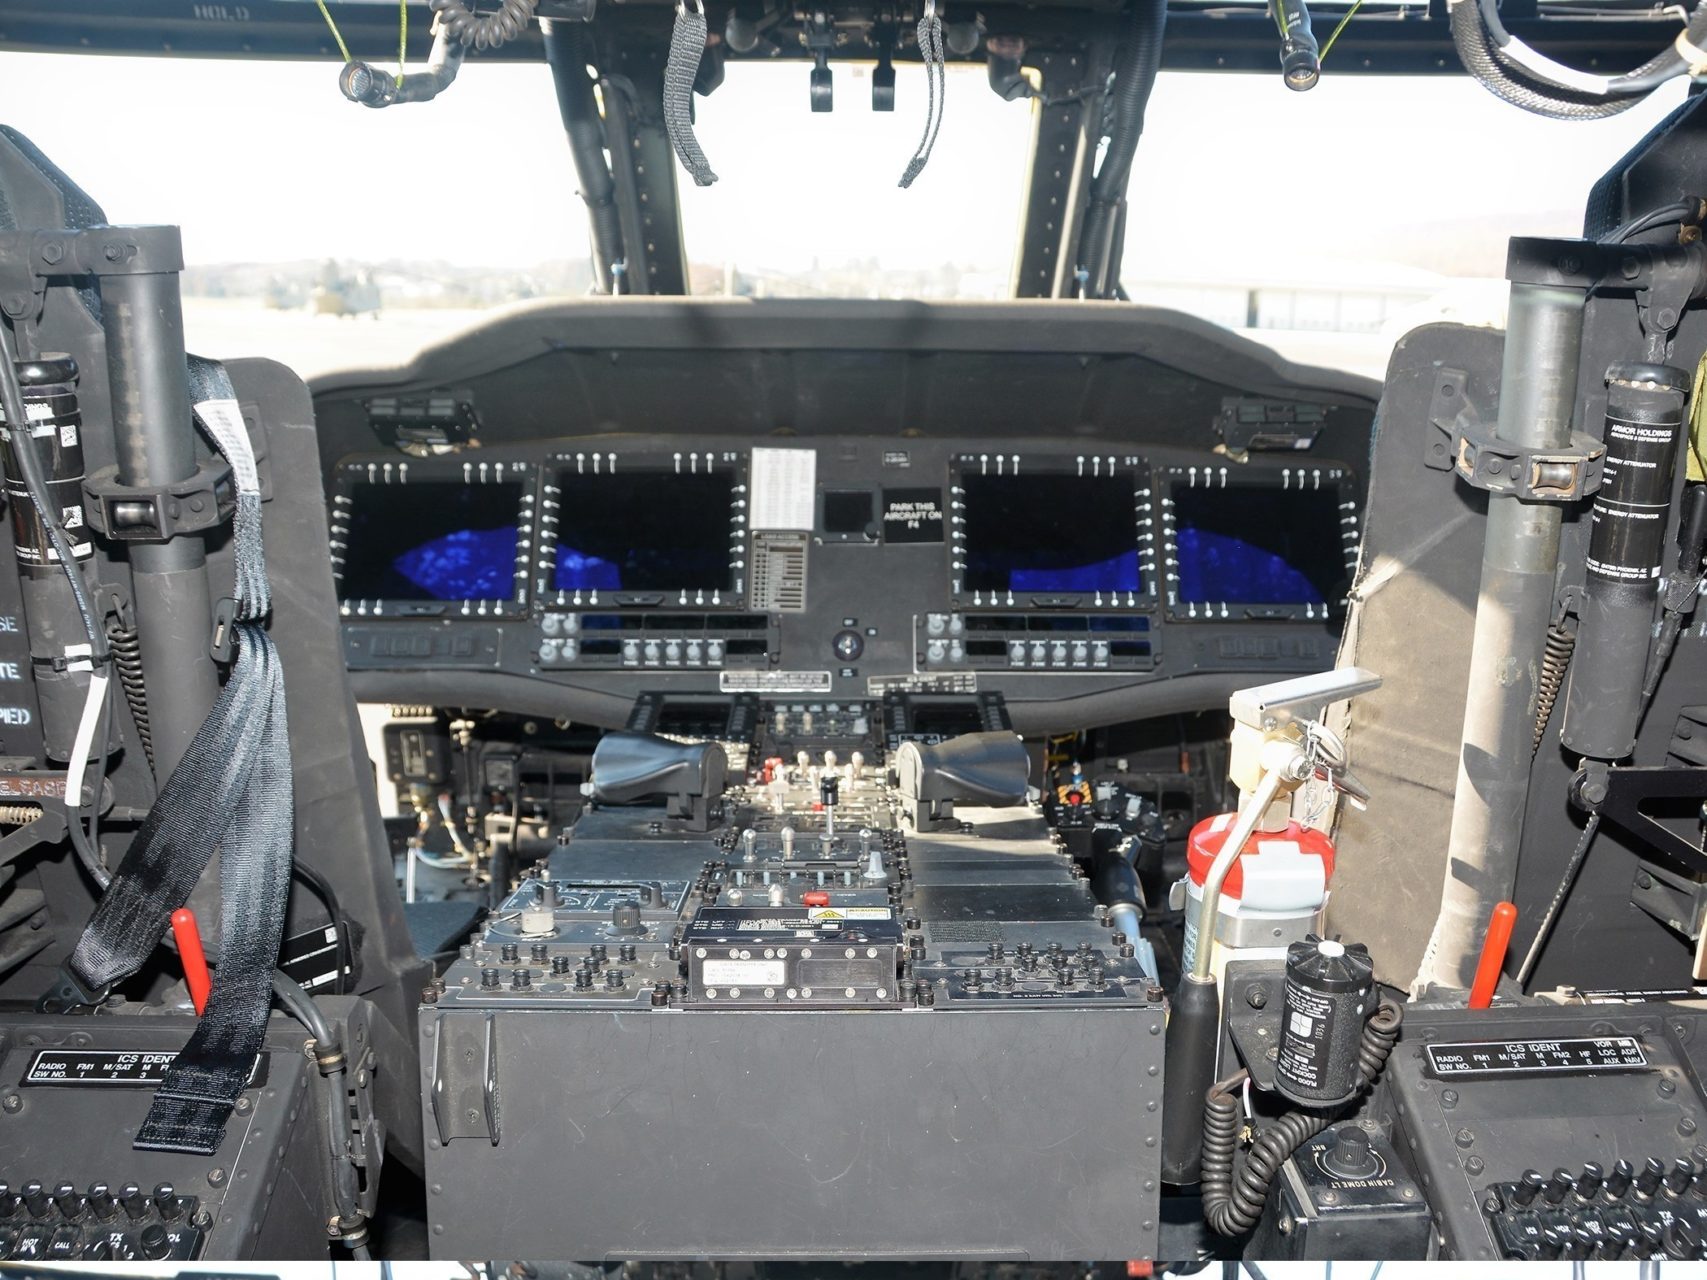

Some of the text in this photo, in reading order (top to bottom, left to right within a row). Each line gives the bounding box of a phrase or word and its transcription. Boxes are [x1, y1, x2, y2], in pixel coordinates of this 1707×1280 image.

[1611, 424, 1672, 437] ARMOR HOLDINGS
[890, 502, 935, 511] PARK THIS
[884, 511, 942, 521] AIRCRAFT ON
[1505, 1043, 1561, 1053] ICS IDENT
[1594, 1040, 1612, 1048] VOR
[1436, 1054, 1464, 1063] RADIO
[1498, 1053, 1526, 1061] M/SAT
[1552, 1051, 1571, 1059] FM2
[1579, 1050, 1591, 1058] HF
[1598, 1048, 1637, 1057] LOC ADF
[117, 1055, 138, 1063] ICS
[1603, 1056, 1641, 1065] AUX NAV
[1438, 1063, 1454, 1071] SW
[1513, 1060, 1520, 1068] 2
[109, 1233, 123, 1241] TX
